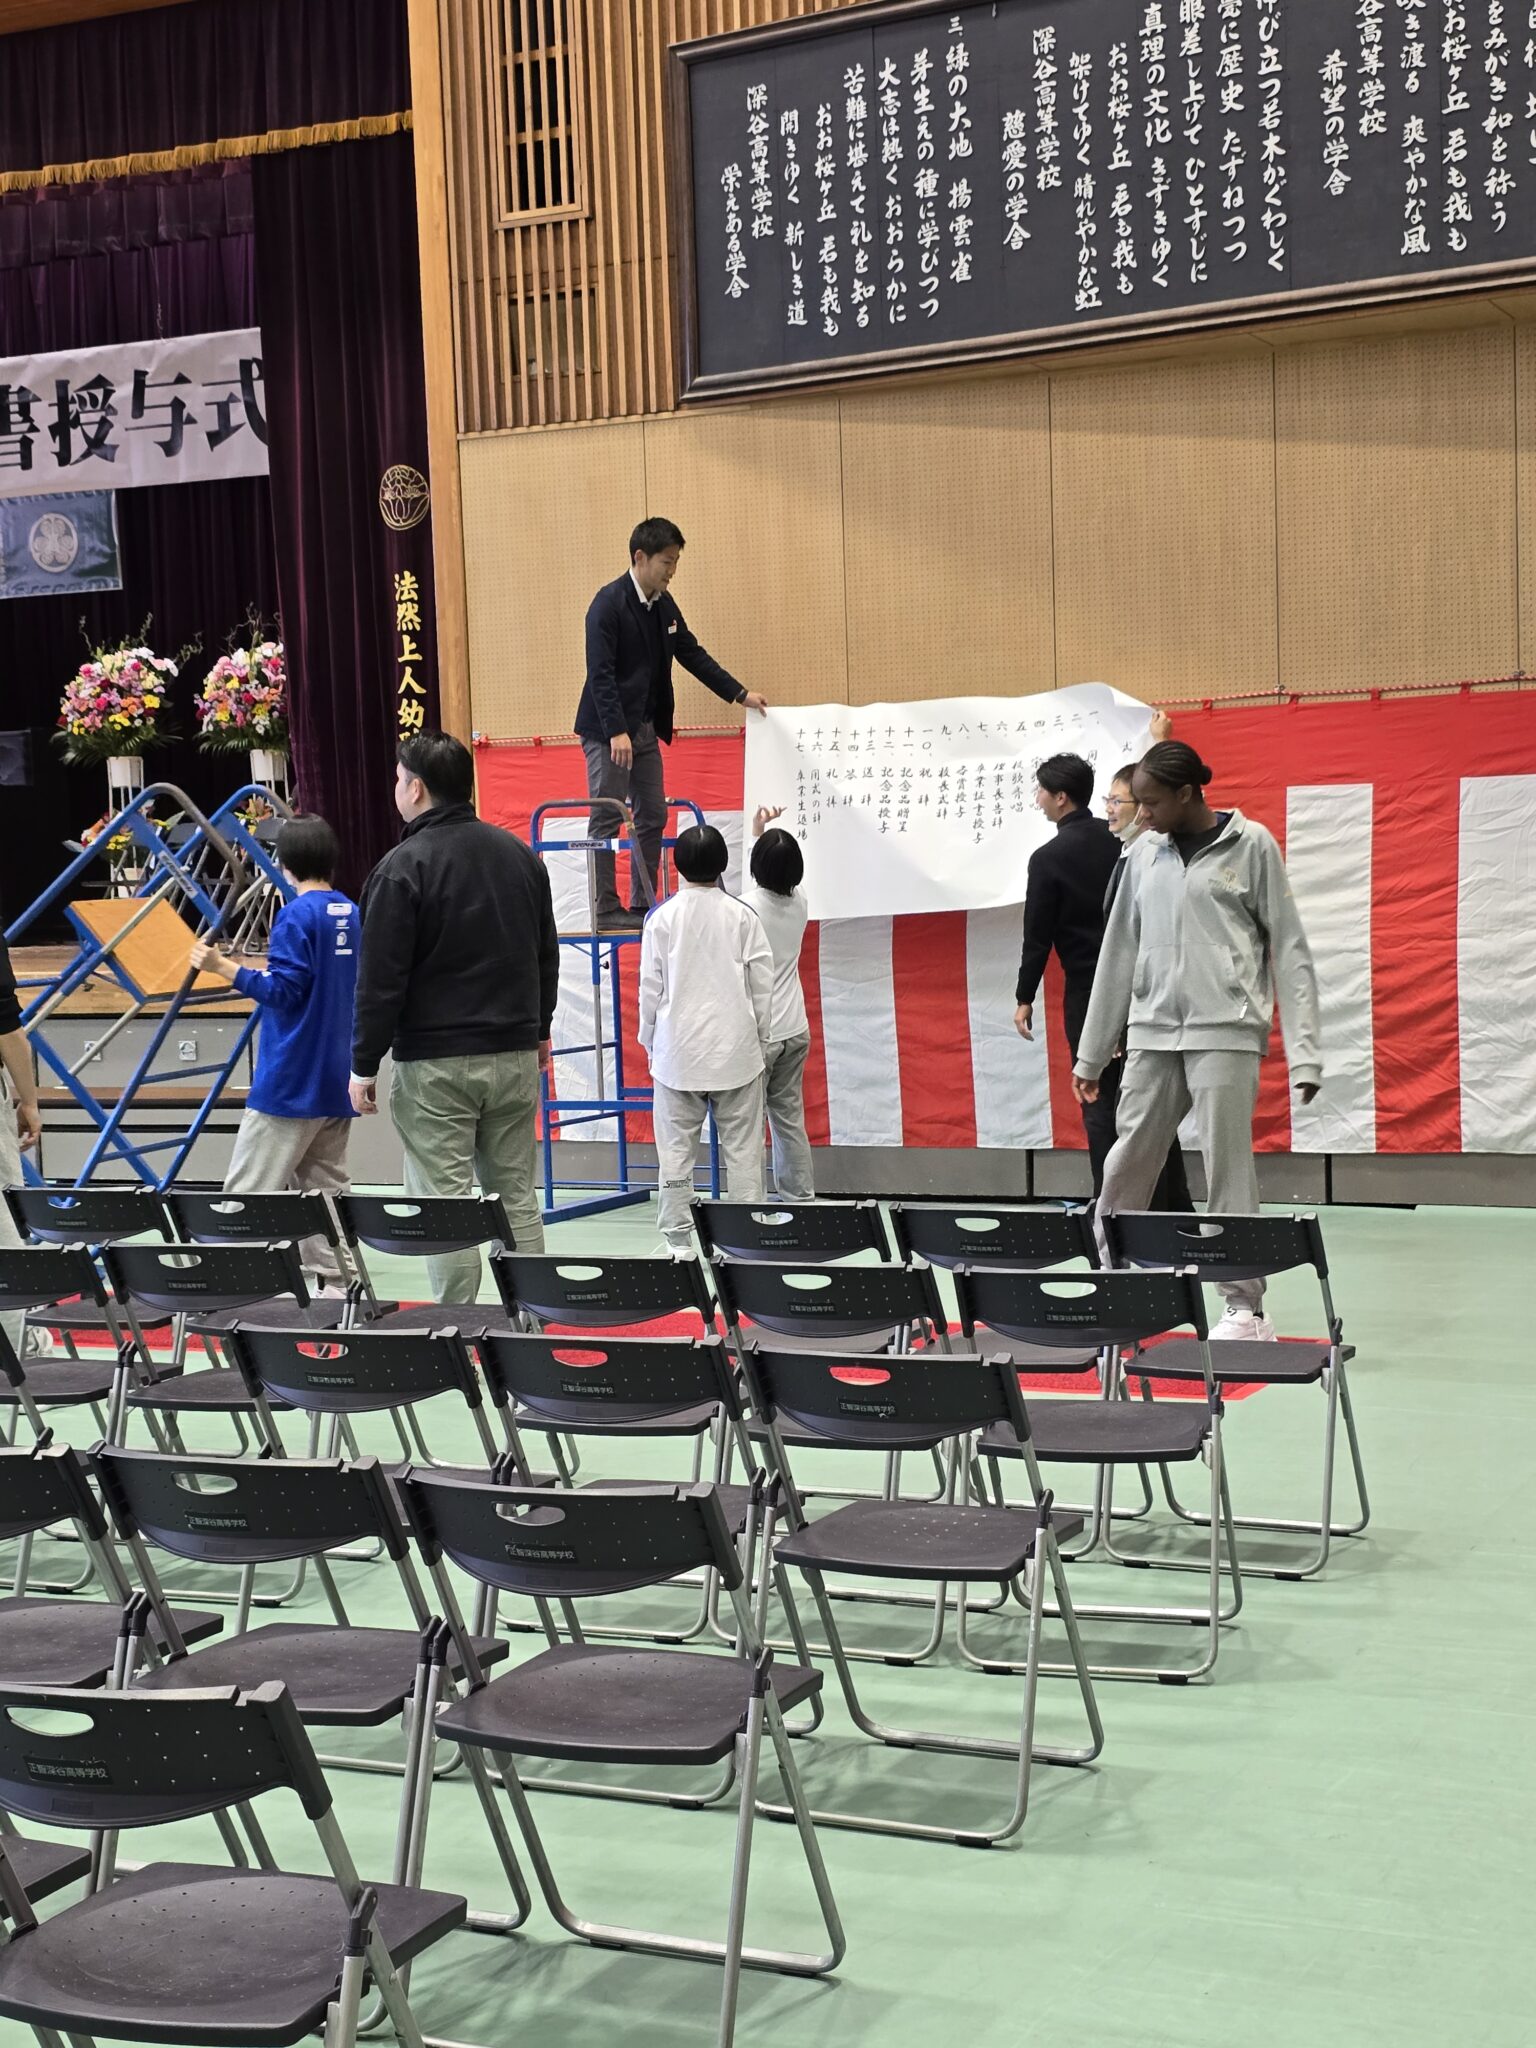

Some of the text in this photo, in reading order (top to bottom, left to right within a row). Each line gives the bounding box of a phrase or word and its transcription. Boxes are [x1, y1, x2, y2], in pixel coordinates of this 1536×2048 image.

[945, 42, 973, 161] 緑の大地
[1032, 25, 1063, 191] 深谷高等学校
[1318, 48, 1352, 196] 希望の学舎
[1441, 0, 1472, 115] お桜ヶ丘
[746, 83, 775, 240] 深谷高等学校
[877, 56, 907, 324] 大志は熱く おおらかに
[910, 47, 941, 318] 芽生えの 種に学びつつ
[1001, 109, 1032, 251] 慈愛の学舎
[1068, 51, 1103, 312] 架けてゆく 晴れやかな虹
[1138, 2, 1173, 288] 真理の文化 きずきゆく
[1218, 127, 1247, 262] たずねつつ
[1400, 114, 1431, 256] 爽やかな風
[720, 162, 750, 299] 栄えある学舎
[780, 108, 808, 326] 開きゆく 新しき道
[849, 220, 876, 328] 礼を知る
[947, 177, 974, 283] 揚雲雀
[1183, 157, 1208, 284] ひとすじに
